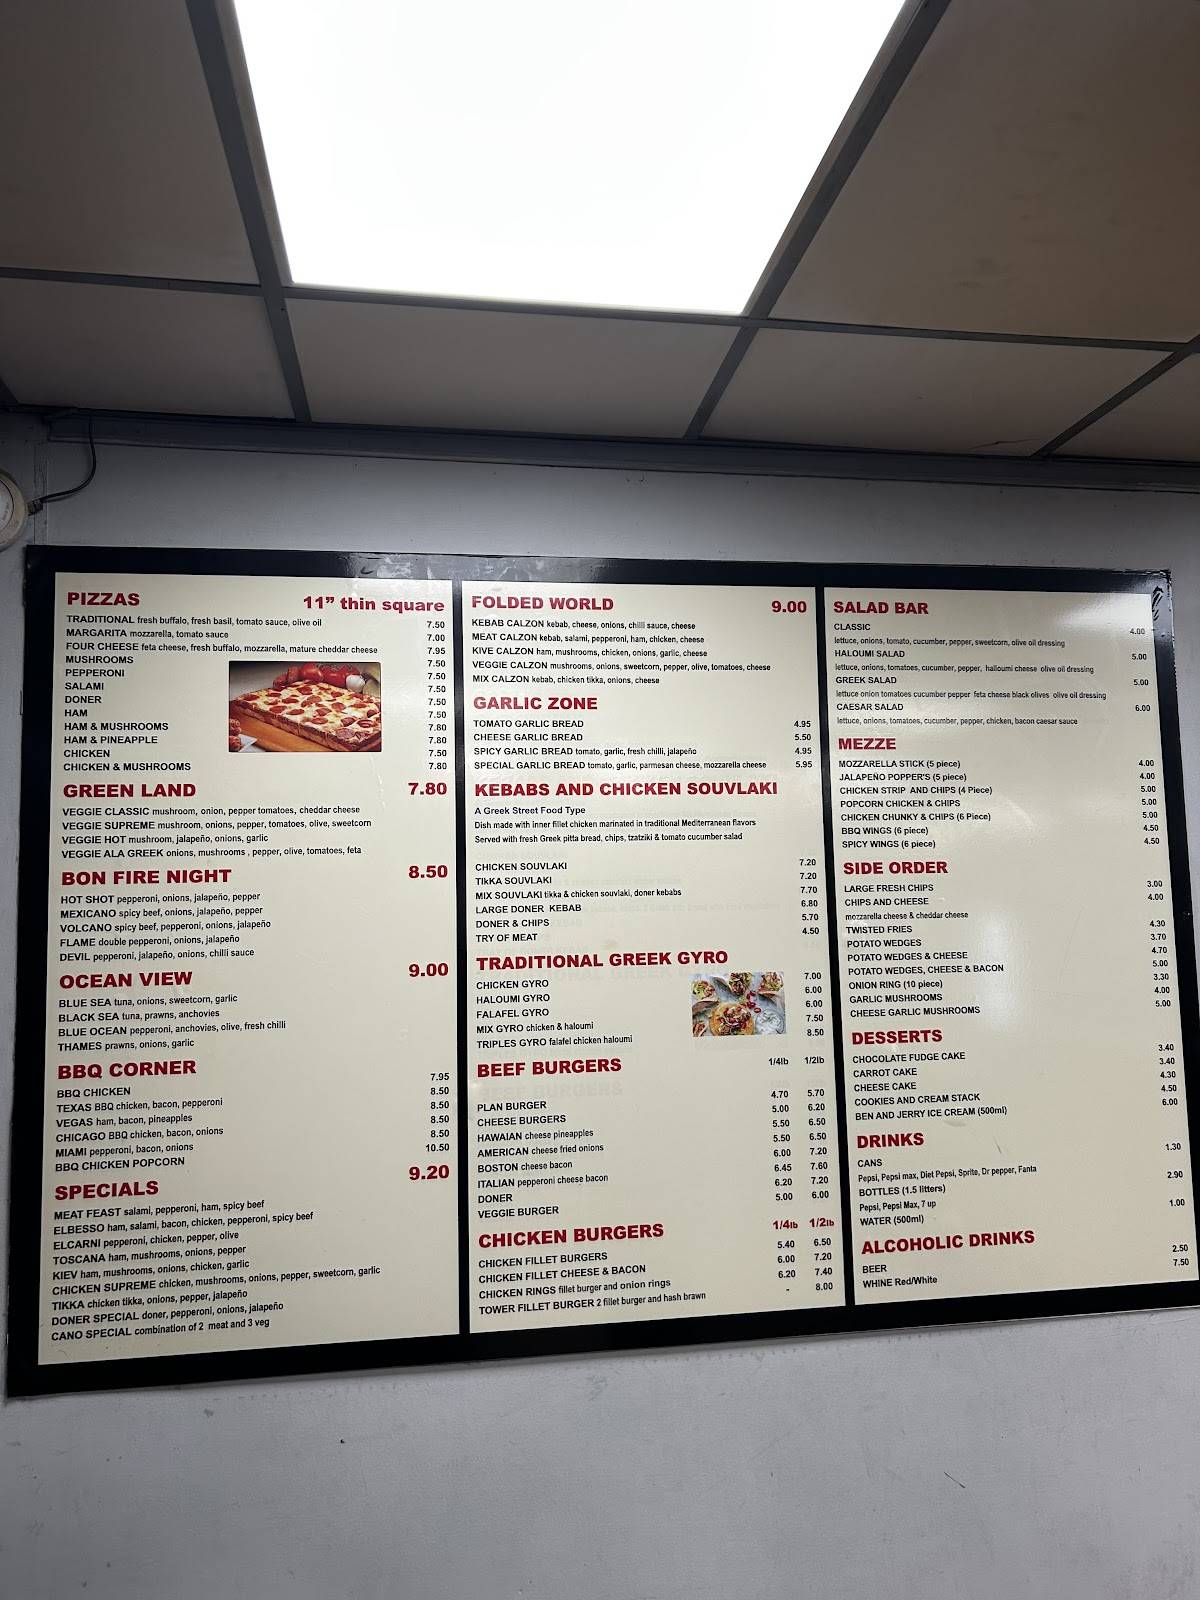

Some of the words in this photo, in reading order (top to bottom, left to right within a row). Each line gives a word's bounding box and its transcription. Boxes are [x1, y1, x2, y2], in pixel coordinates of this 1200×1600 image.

[68, 592, 139, 606] PIZZAS
[340, 597, 375, 610] thin
[382, 601, 444, 613] square
[472, 596, 543, 609] FOLDED
[549, 598, 613, 610] WORLD
[772, 601, 806, 613] 9.00
[834, 601, 889, 613] SALAD
[895, 602, 928, 614] BAR
[67, 615, 135, 623] TRADITIONAL
[137, 616, 157, 624] fresh
[160, 617, 189, 625] buffalo,
[214, 617, 234, 626] basil,
[67, 629, 127, 637] MARGARITA
[130, 630, 174, 639] mozzarella,
[66, 669, 124, 677] PEPPERONI
[474, 697, 542, 709] GARLIC
[548, 697, 597, 709] ZONE
[64, 736, 87, 744] HAM
[90, 736, 97, 744] &
[101, 736, 157, 744] PINEAPPLE
[839, 738, 896, 750] MEZZE
[927, 760, 934, 768] (5
[64, 784, 133, 798] GREEN
[142, 784, 196, 797] LAND
[408, 783, 447, 795] 7.80
[475, 784, 549, 796] KEBABS
[556, 783, 593, 796] AND
[600, 783, 681, 795] CHICKEN
[687, 782, 777, 795] SOUVLAKI
[409, 865, 447, 878] 8.50
[476, 863, 517, 871] CHICKEN
[844, 862, 883, 874] SIDE
[889, 861, 948, 874] ORDER
[62, 871, 105, 885] BON
[114, 871, 159, 884] FIRE
[167, 869, 232, 883] NIGHT
[61, 896, 83, 904] HOT
[86, 895, 114, 903] SHOT
[117, 894, 160, 904] pepperoni,
[162, 894, 192, 903] onions,
[194, 893, 230, 903] jalapeño,
[233, 894, 260, 902] pepper
[513, 933, 538, 941] MEAT
[476, 954, 603, 970] TRADITIONAL
[609, 952, 672, 966] GREEK
[678, 951, 728, 964] GYRO
[924, 952, 932, 961] &
[409, 963, 448, 977] 9.00
[60, 973, 132, 989] OCEAN
[139, 971, 192, 986] VIEW
[476, 981, 518, 989] CHICKEN
[522, 980, 548, 988] GYRO
[59, 1028, 87, 1036] BLUE
[90, 1027, 127, 1036] OCEAN
[130, 1025, 173, 1036] pepperoni,
[175, 1024, 218, 1032] anchovies,
[221, 1023, 242, 1031] olive,
[245, 1022, 264, 1030] fresh
[852, 1030, 942, 1045] DESSERTS
[805, 1056, 824, 1064] 1/2lb
[58, 1064, 102, 1079] BBQ
[109, 1061, 196, 1077] CORNER
[478, 1062, 525, 1077] BEEF
[533, 1058, 621, 1075] BURGERS
[57, 1089, 80, 1098] BBQ
[83, 1087, 130, 1097] CHICKEN
[431, 1087, 449, 1095] 8.50
[808, 1103, 825, 1111] 6.20
[477, 1117, 516, 1126] CHEESE
[519, 1115, 566, 1124] BURGERS
[857, 1133, 924, 1148] DRINKS
[426, 1143, 449, 1152] 10.50
[774, 1149, 791, 1157] 6.00
[810, 1147, 827, 1155] 7.20
[56, 1163, 79, 1171] BBQ
[82, 1160, 129, 1170] CHICKEN
[133, 1157, 184, 1167] POPCORN
[478, 1163, 518, 1173] BOSTON
[550, 1161, 572, 1169] bacon
[858, 1159, 882, 1167] CANS
[409, 1165, 449, 1180] 9.20
[55, 1181, 158, 1199] SPECIALS
[773, 1220, 798, 1229] 1/4lb
[810, 1218, 834, 1227] 1/2lb
[860, 1217, 891, 1226] WATER
[894, 1215, 924, 1225] (500ml)
[479, 1229, 566, 1246] CHICKEN
[574, 1224, 663, 1242] BURGERS
[778, 1240, 794, 1248] 5.40
[814, 1238, 831, 1246] 6.50
[862, 1235, 963, 1254] ALCOHOLIC
[969, 1230, 1034, 1247] DRINKS
[1172, 1244, 1188, 1252] 2.50
[479, 1258, 522, 1268] CHICKEN
[526, 1256, 558, 1265] FILLET
[560, 1252, 607, 1263] BURGERS
[863, 1265, 887, 1273] BEER
[52, 1331, 83, 1341] CANO
[86, 1328, 132, 1338] SPECIAL
[135, 1324, 186, 1335] combination
[188, 1322, 197, 1331] of
[198, 1321, 204, 1331] 2
[208, 1321, 228, 1330] meat
[230, 1319, 245, 1328] and
[247, 1318, 253, 1328] 3
[255, 1319, 269, 1328] veg
